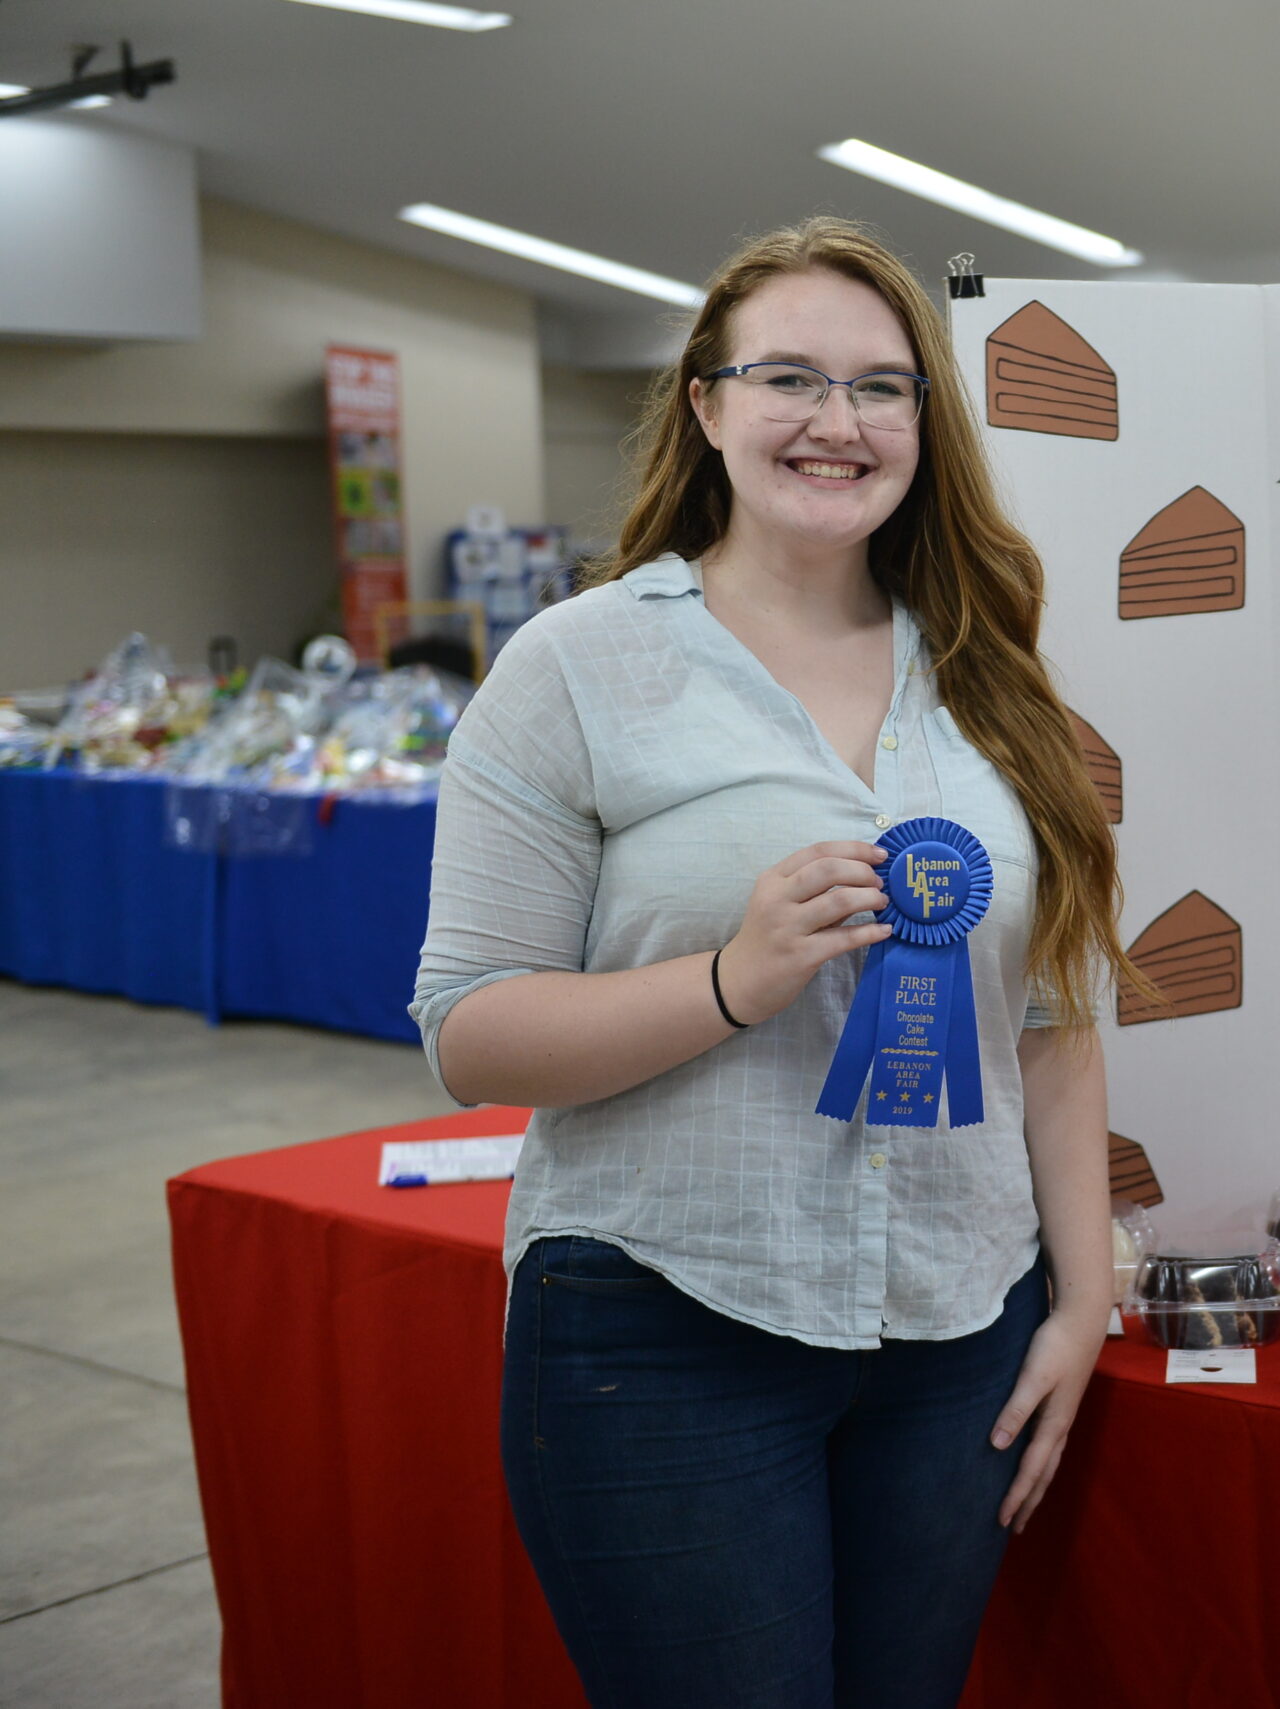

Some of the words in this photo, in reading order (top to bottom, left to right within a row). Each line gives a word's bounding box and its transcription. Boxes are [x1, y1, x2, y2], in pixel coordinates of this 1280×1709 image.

[906, 854, 960, 888] Lebanon
[913, 871, 949, 897] Area
[923, 891, 955, 918] Fair
[899, 976, 936, 991] FIRST
[895, 991, 936, 1006] PLACE
[897, 1011, 934, 1024] Chocolate
[906, 1023, 925, 1035] Cake
[899, 1035, 928, 1046] Contest
[887, 1061, 932, 1071] LEBANON
